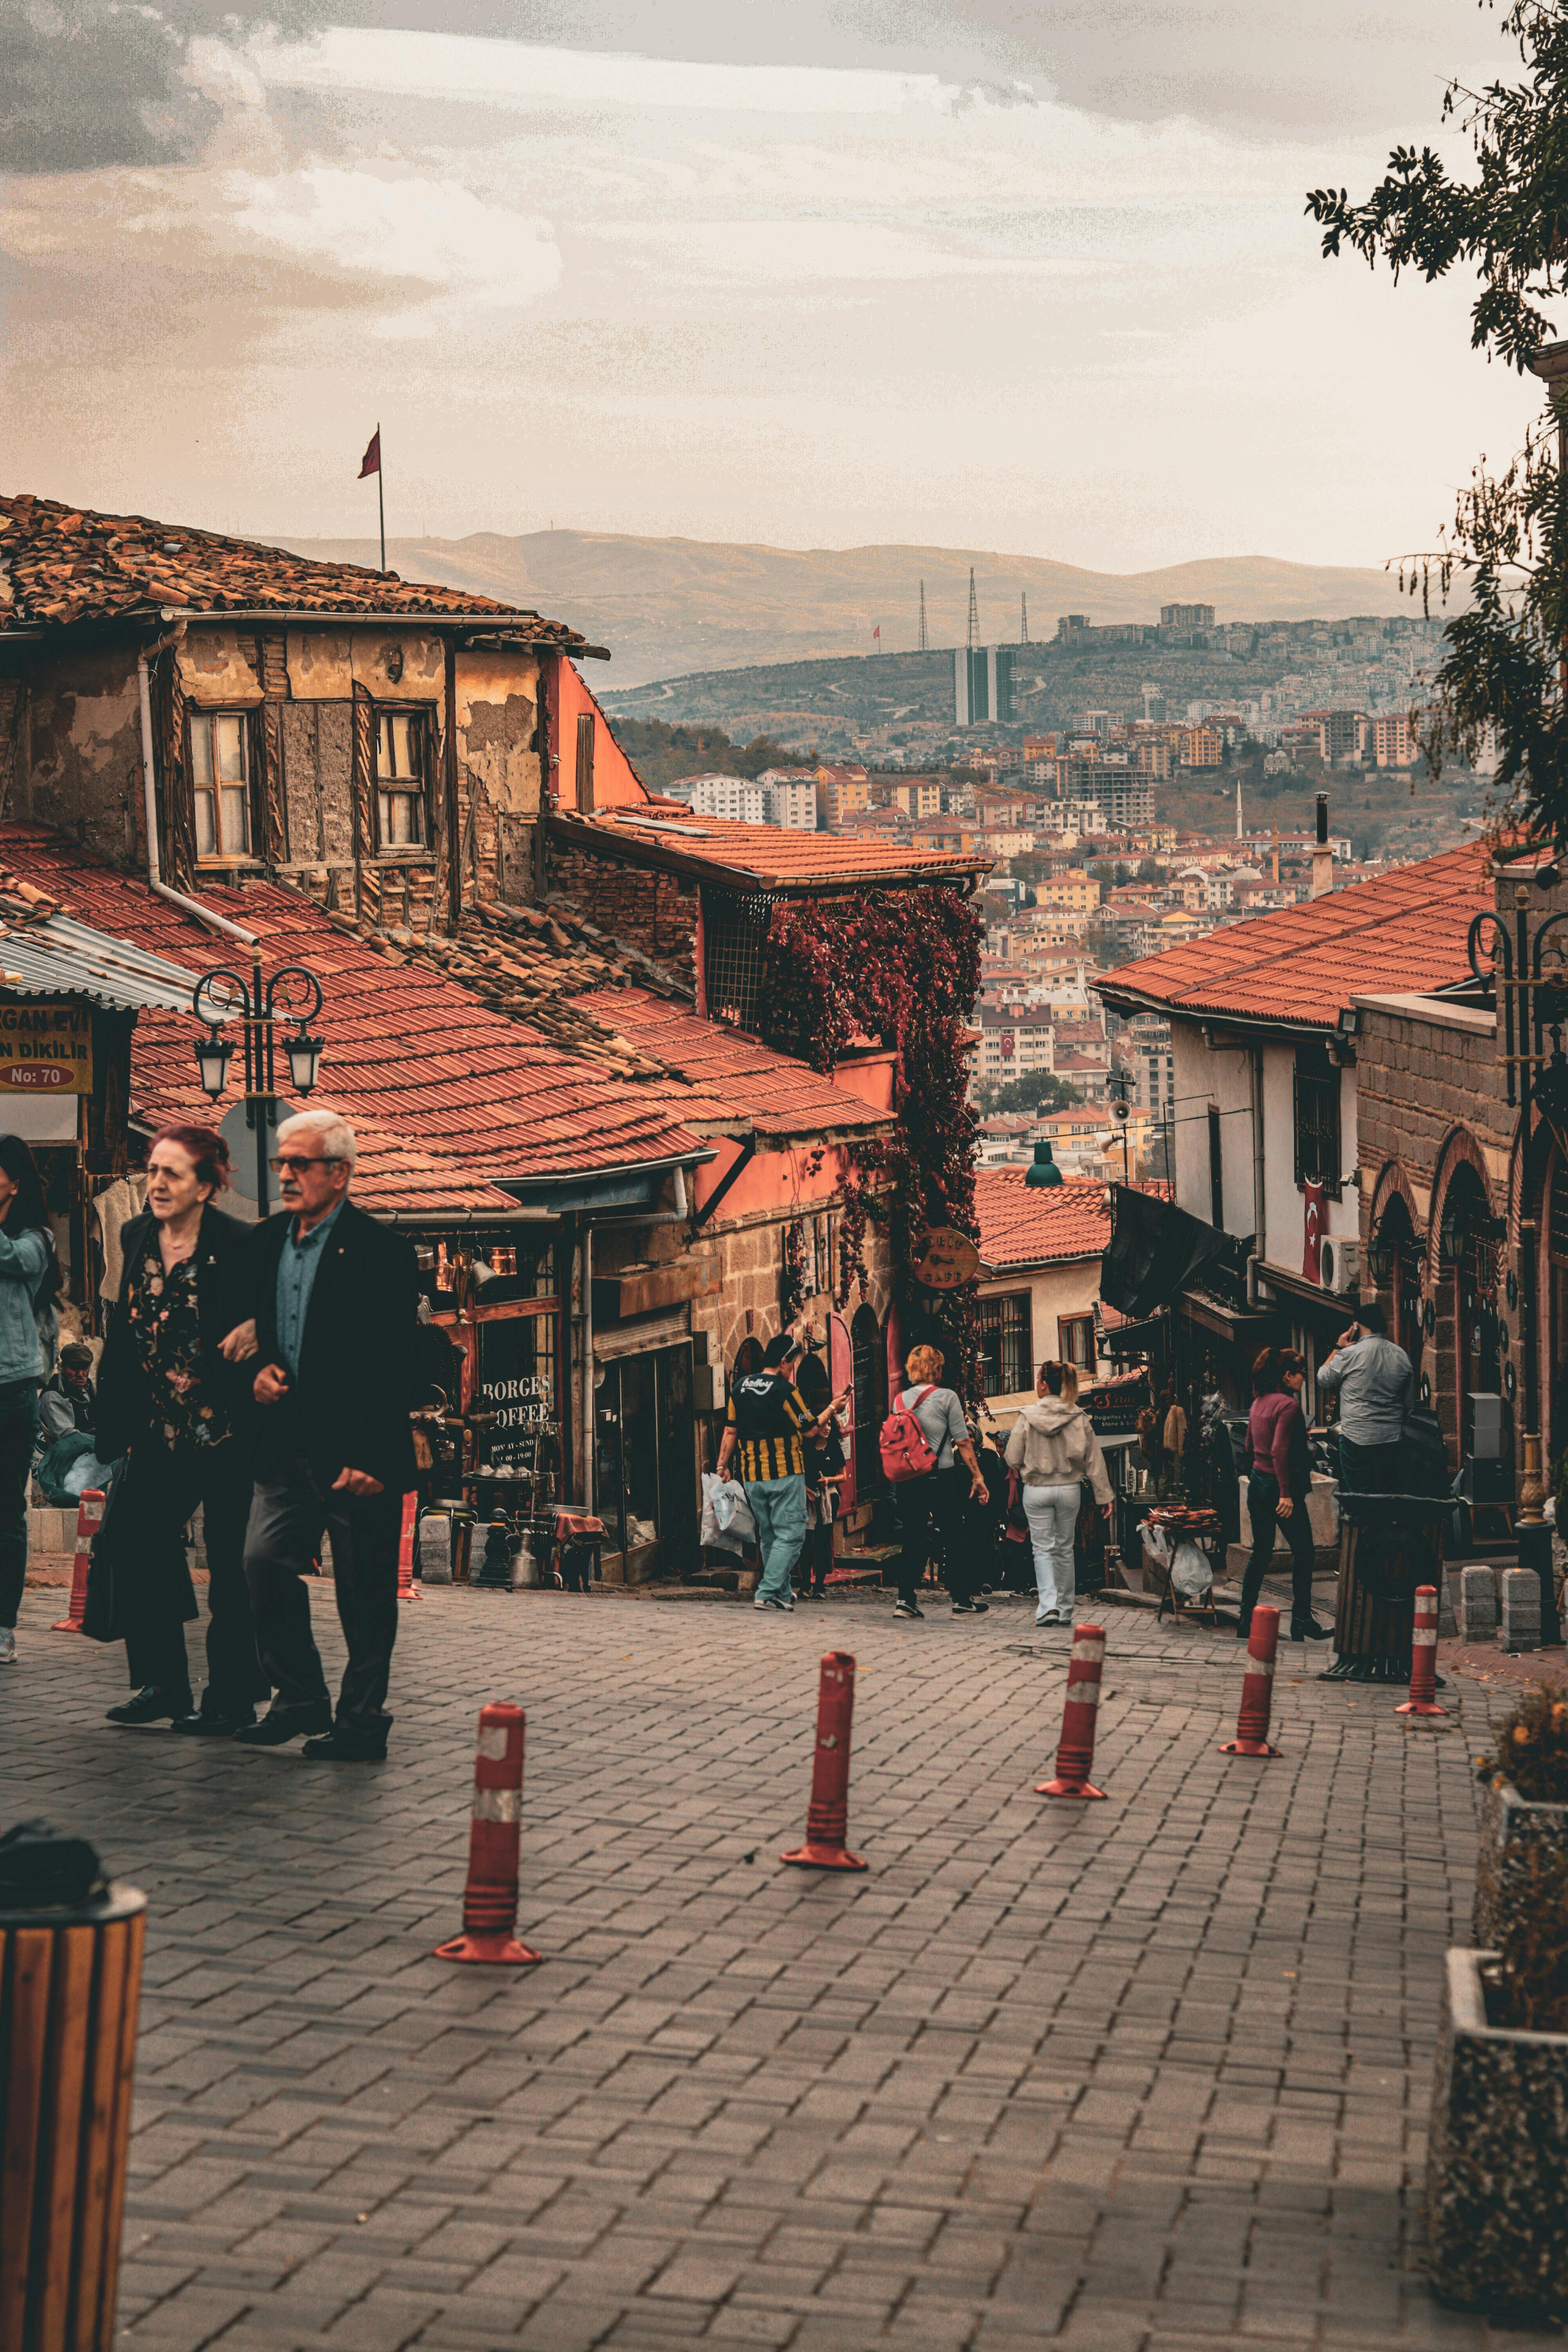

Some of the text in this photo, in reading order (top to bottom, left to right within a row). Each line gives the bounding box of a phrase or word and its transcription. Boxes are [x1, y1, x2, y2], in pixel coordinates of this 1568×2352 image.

[0, 1008, 48, 1031] GAN
[19, 1040, 87, 1059] DİKİLİR
[11, 1068, 60, 1083] No: 70
[924, 1272, 962, 1281] CAFE
[482, 1375, 550, 1401] BORGES
[490, 1402, 549, 1429] OFFEE
[517, 1451, 532, 1460] 19:00
